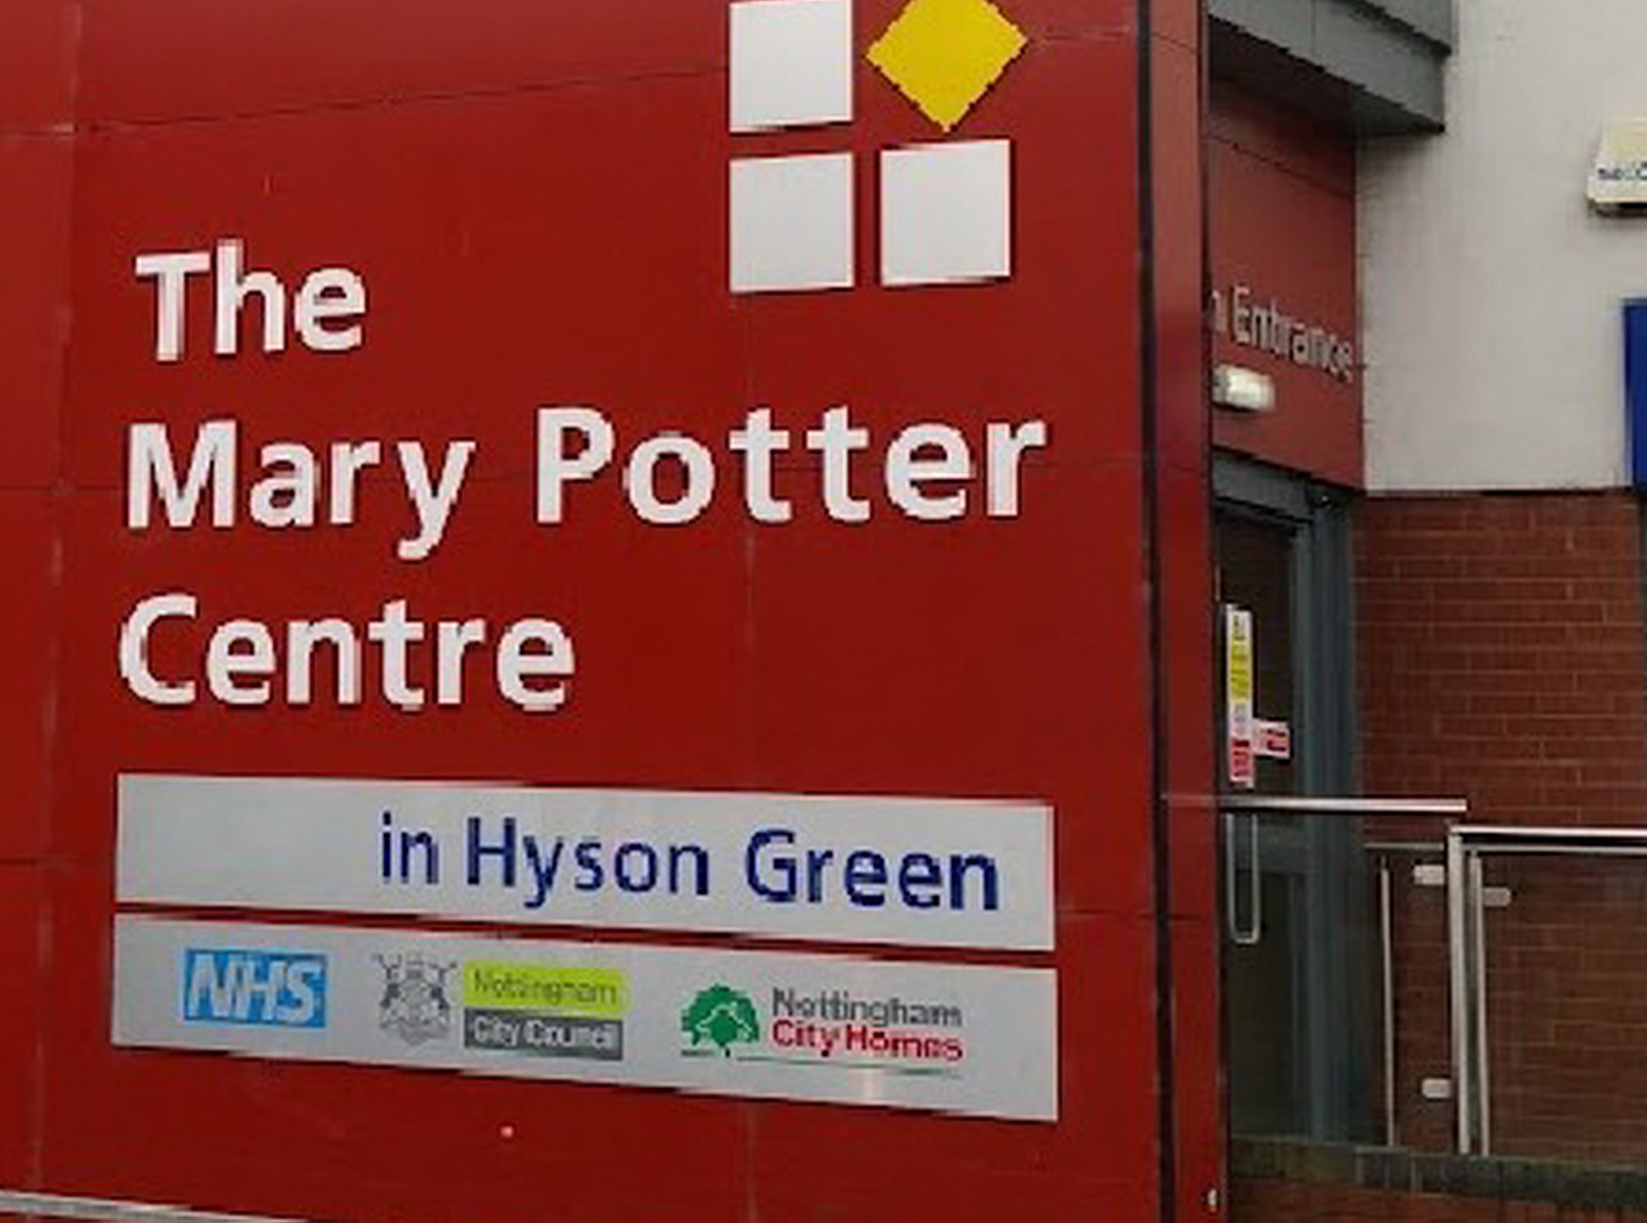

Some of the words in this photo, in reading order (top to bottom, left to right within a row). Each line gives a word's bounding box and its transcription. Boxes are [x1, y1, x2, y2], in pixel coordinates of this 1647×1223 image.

[135, 239, 366, 360] The
[128, 421, 476, 559] Mary
[536, 406, 1047, 524] Potter
[119, 593, 575, 711] Centre
[381, 813, 439, 886] in
[466, 816, 710, 910] Hyson
[744, 827, 1000, 912] Green
[187, 954, 322, 1025] NHS
[473, 1016, 521, 1047] City
[772, 987, 963, 1028] Nottingham
[771, 1019, 835, 1059] City
[845, 1023, 964, 1062] Homes
